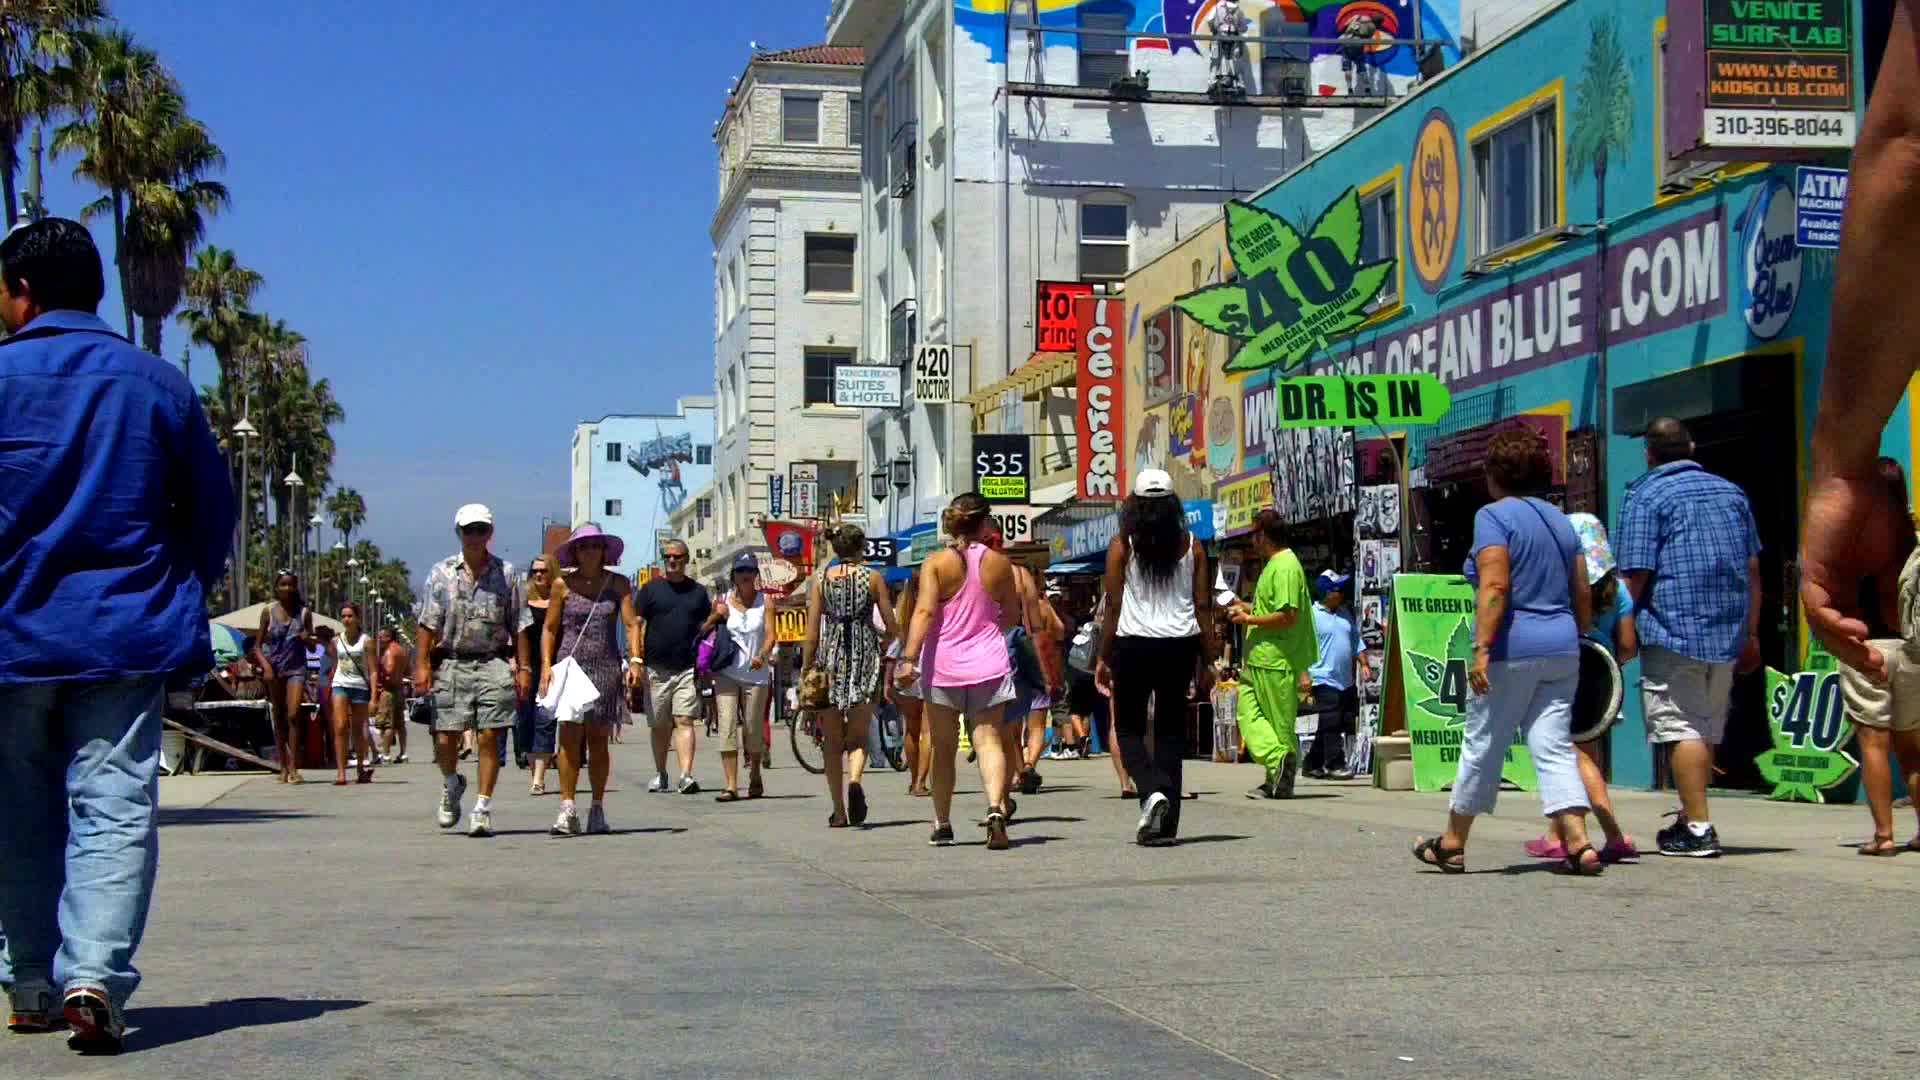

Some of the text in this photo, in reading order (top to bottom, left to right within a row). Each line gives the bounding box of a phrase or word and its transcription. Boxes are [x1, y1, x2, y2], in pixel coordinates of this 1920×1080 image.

[1731, 0, 1823, 20] VENICE
[1712, 24, 1842, 45] SURF-LAB
[1718, 62, 1838, 79] WWW.VENICE
[1711, 81, 1845, 97] KIDSCLUB.COM
[1716, 116, 1843, 137] 310-396-8044
[1801, 173, 1848, 198] ATM
[1799, 197, 1843, 210] MACHIN
[1219, 237, 1352, 339] $40
[1491, 272, 1582, 368] BLUE
[1610, 221, 1720, 331] .COM
[1040, 285, 1077, 320] to
[1260, 287, 1361, 355] MEDICAL MARIJUANA
[916, 347, 949, 377] 420
[837, 379, 886, 391] SUITES
[916, 379, 950, 400] DOCTOR
[840, 391, 898, 403] & HOTEL
[1281, 379, 1422, 421] DR. IS IN
[976, 451, 1023, 476] $35
[1401, 597, 1423, 613] THE
[1426, 597, 1462, 614] GREEN
[1425, 658, 1470, 715] $4
[1772, 672, 1845, 751] $40
